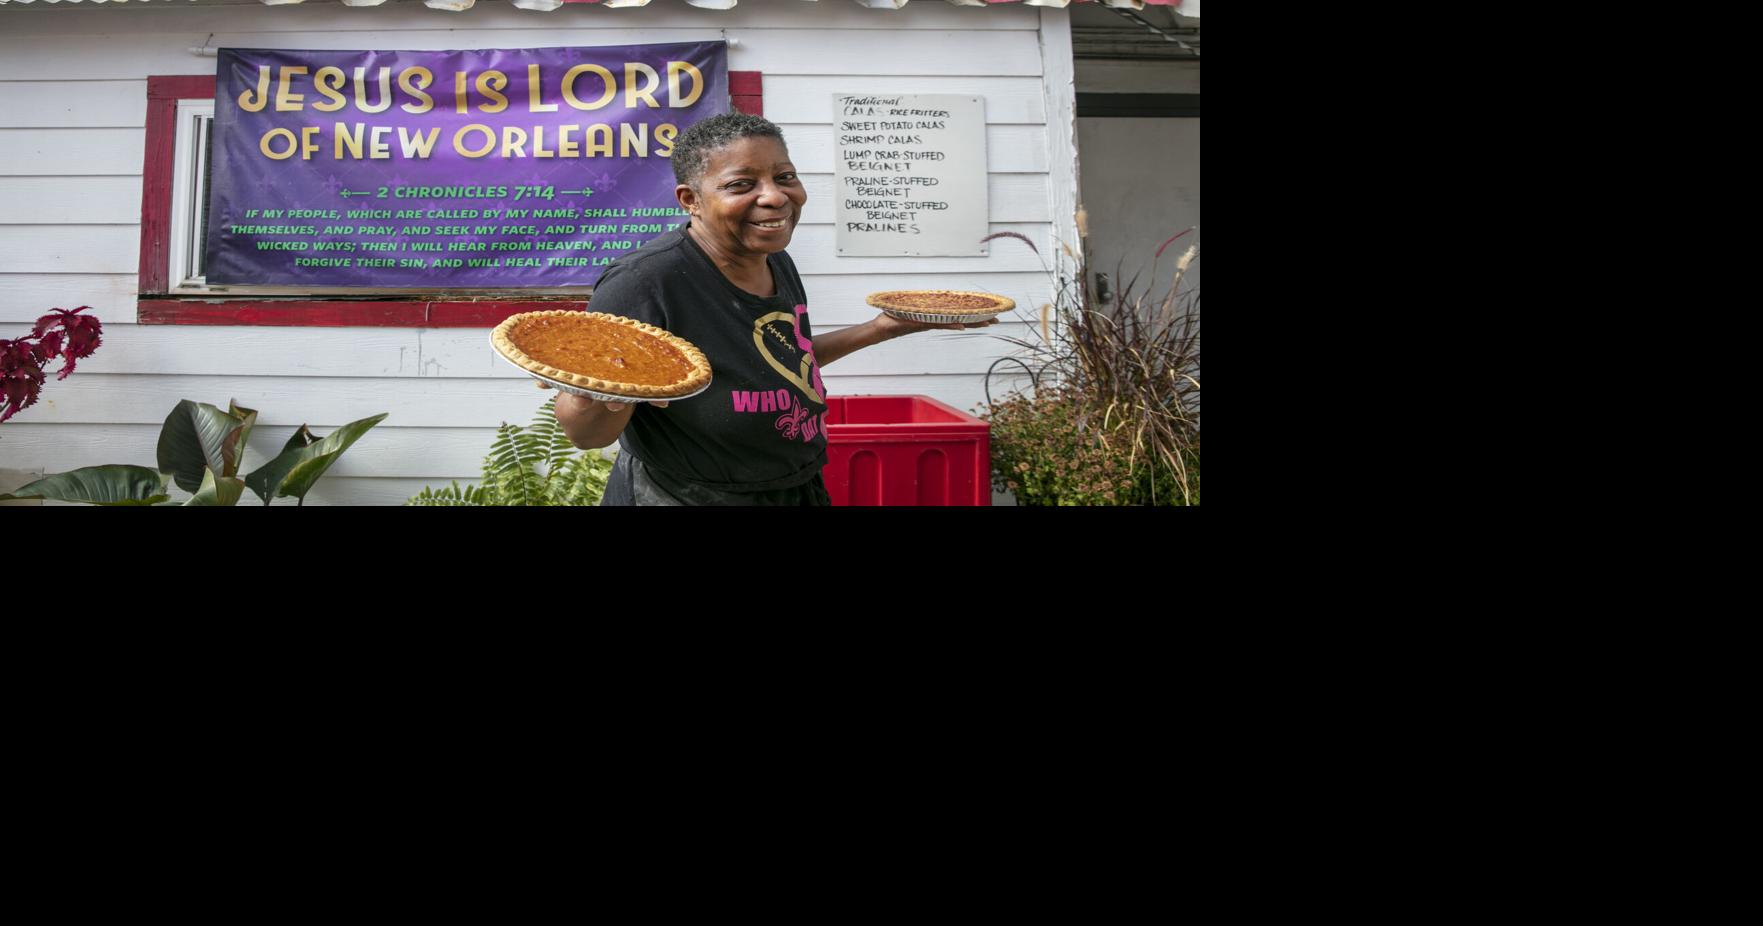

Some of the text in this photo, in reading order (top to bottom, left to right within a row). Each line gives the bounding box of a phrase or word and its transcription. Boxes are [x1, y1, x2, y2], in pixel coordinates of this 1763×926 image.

[238, 61, 704, 114] JESUS IS LORD
[840, 120, 945, 131] SWEET POTATO CALAS
[260, 123, 678, 160] OF NEW ORLEANS
[840, 134, 923, 146] SHRIMP CALAS
[844, 149, 872, 160] LUMP
[847, 161, 911, 172] BEIGNET
[376, 185, 555, 201] 2 CHRONICLES 7:14
[856, 187, 910, 198] BEIGNET
[245, 209, 259, 219] IF
[262, 209, 284, 219] MY
[287, 209, 341, 221] PEOPLE,
[347, 209, 392, 219] WHICH
[395, 209, 423, 219] ARE
[427, 209, 479, 219] CALLED
[482, 209, 501, 219] BY
[505, 209, 529, 219] MY
[532, 208, 580, 220] NAME,
[584, 207, 627, 218] SHALL
[866, 211, 917, 221] BEIGNET
[230, 225, 319, 236] THEMSELVES,
[323, 225, 354, 235] AND
[358, 225, 397, 237] PRAY,
[401, 225, 432, 235] AND
[435, 226, 469, 235] SEEK
[474, 225, 498, 235] MY
[501, 225, 540, 236] FACE,
[544, 224, 575, 234] AND
[580, 224, 617, 234] TURN
[622, 223, 662, 233] FROM
[847, 222, 921, 234] PRALINES
[256, 241, 308, 250] WICKED
[313, 242, 356, 252] WAYS;
[361, 242, 397, 251] THEN
[402, 242, 407, 251] I
[411, 242, 443, 251] WILL
[448, 242, 486, 251] HEAR
[490, 242, 531, 251] FROM
[536, 241, 597, 252] HEAVEN,
[601, 240, 632, 250] AND
[295, 257, 615, 269] FORGIVE THEIR SIN, AND WILL HEAL THEIR LA
[731, 388, 791, 413] WHO
[800, 414, 818, 442] DAT
